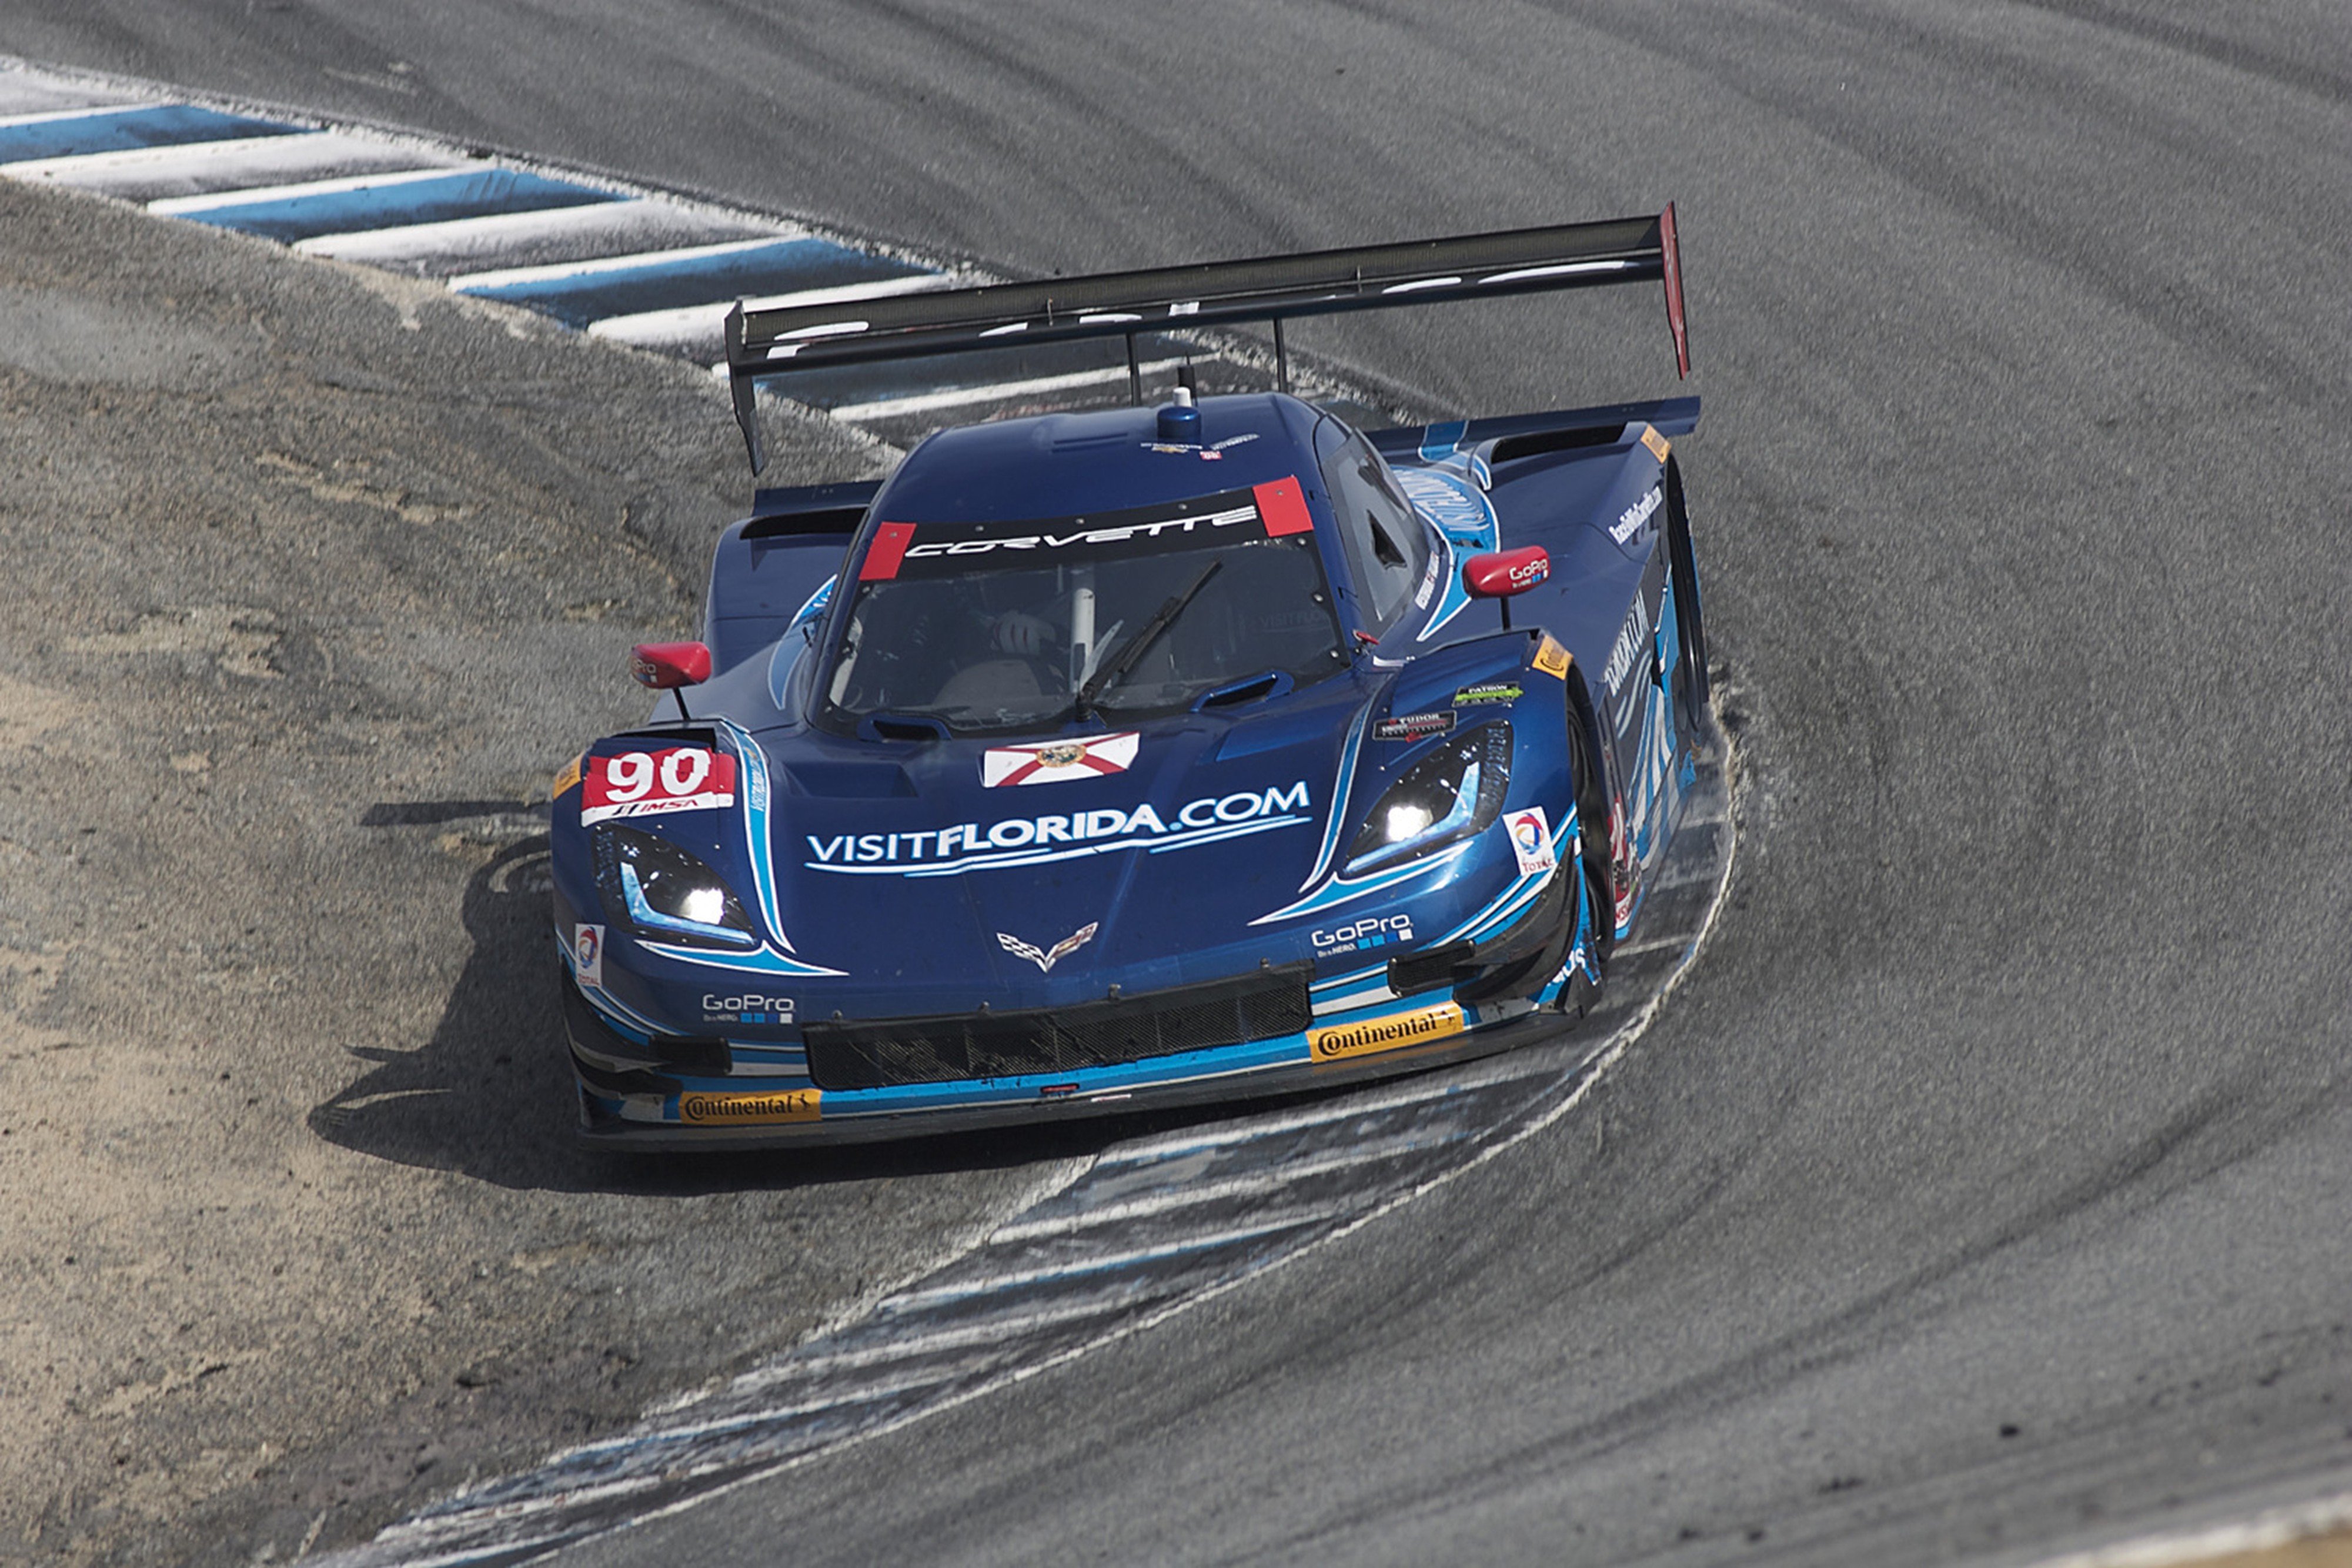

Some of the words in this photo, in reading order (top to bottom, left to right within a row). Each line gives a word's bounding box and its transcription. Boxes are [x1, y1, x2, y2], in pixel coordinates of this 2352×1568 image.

[904, 506, 1257, 557] CORVETTE
[1509, 559, 1548, 581] GoPro
[1399, 713, 1440, 724] TUDOR
[606, 747, 711, 803] 90
[639, 799, 699, 812] IMSA
[806, 780, 1312, 862] VISITFLORIDA.COM
[1522, 858, 1553, 872] TOTAL
[1311, 914, 1410, 947] GoPro
[702, 994, 794, 1012] GoPro
[1318, 1012, 1438, 1057] Continental
[685, 1094, 793, 1121] Continental
